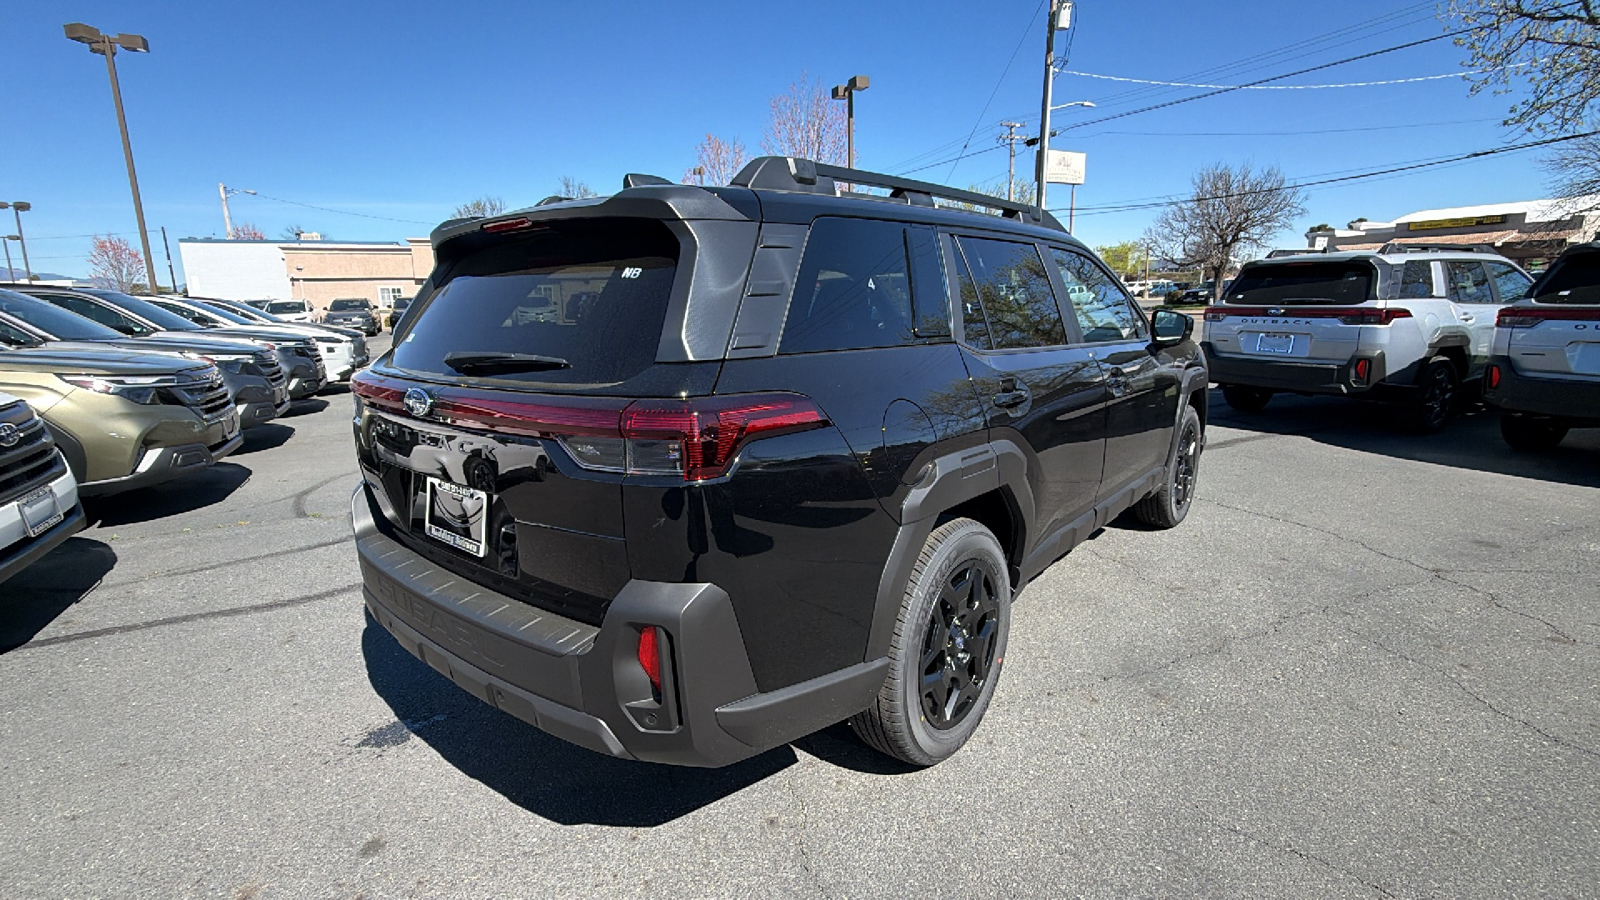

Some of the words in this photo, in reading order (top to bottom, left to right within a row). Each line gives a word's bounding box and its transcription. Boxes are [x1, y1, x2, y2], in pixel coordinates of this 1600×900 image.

[621, 267, 642, 279] NB
[1241, 318, 1313, 326] OUTBACK
[377, 420, 497, 461] OUTBACK
